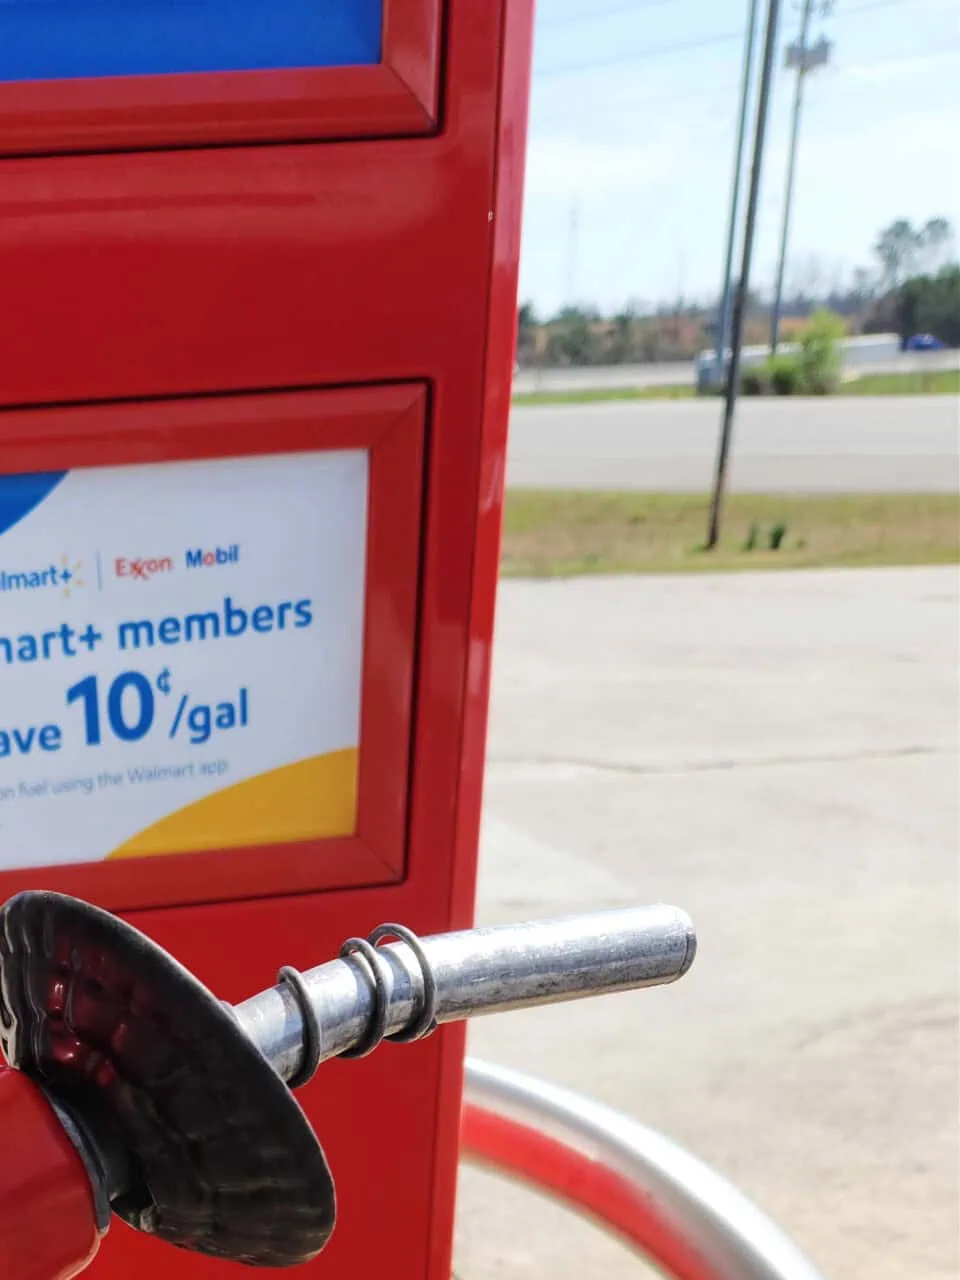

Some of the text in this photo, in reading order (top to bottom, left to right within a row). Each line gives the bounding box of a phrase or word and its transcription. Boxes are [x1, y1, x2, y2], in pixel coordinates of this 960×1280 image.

[115, 545, 240, 580] Exxon Mobil
[117, 595, 313, 650] members
[19, 780, 49, 797] fuel
[52, 776, 94, 794] using
[97, 771, 123, 788] the
[127, 761, 196, 783] Walmart
[199, 759, 229, 776] app
